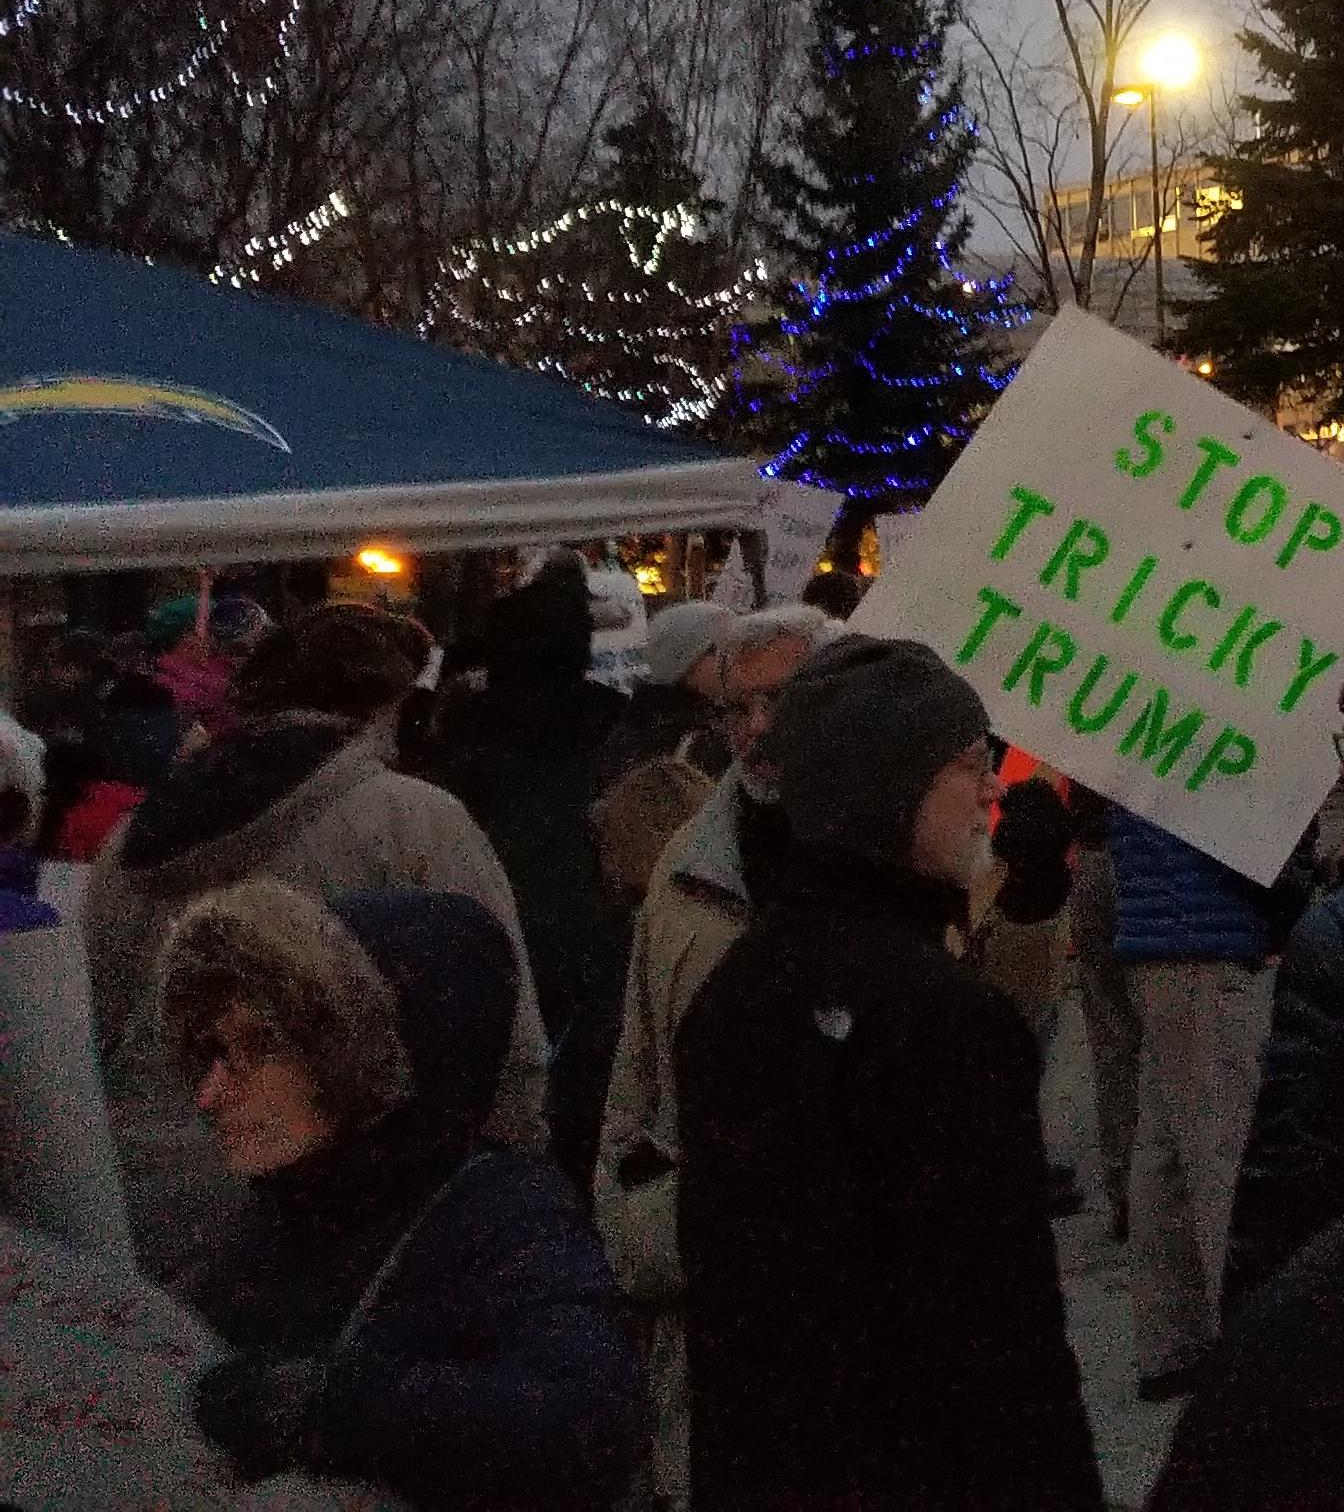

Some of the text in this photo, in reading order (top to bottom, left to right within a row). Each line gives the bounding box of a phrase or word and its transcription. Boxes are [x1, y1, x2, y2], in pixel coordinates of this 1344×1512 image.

[1115, 410, 1343, 569] STOP
[956, 587, 1258, 792] TRUMP
[990, 484, 1338, 713] TRICKY
